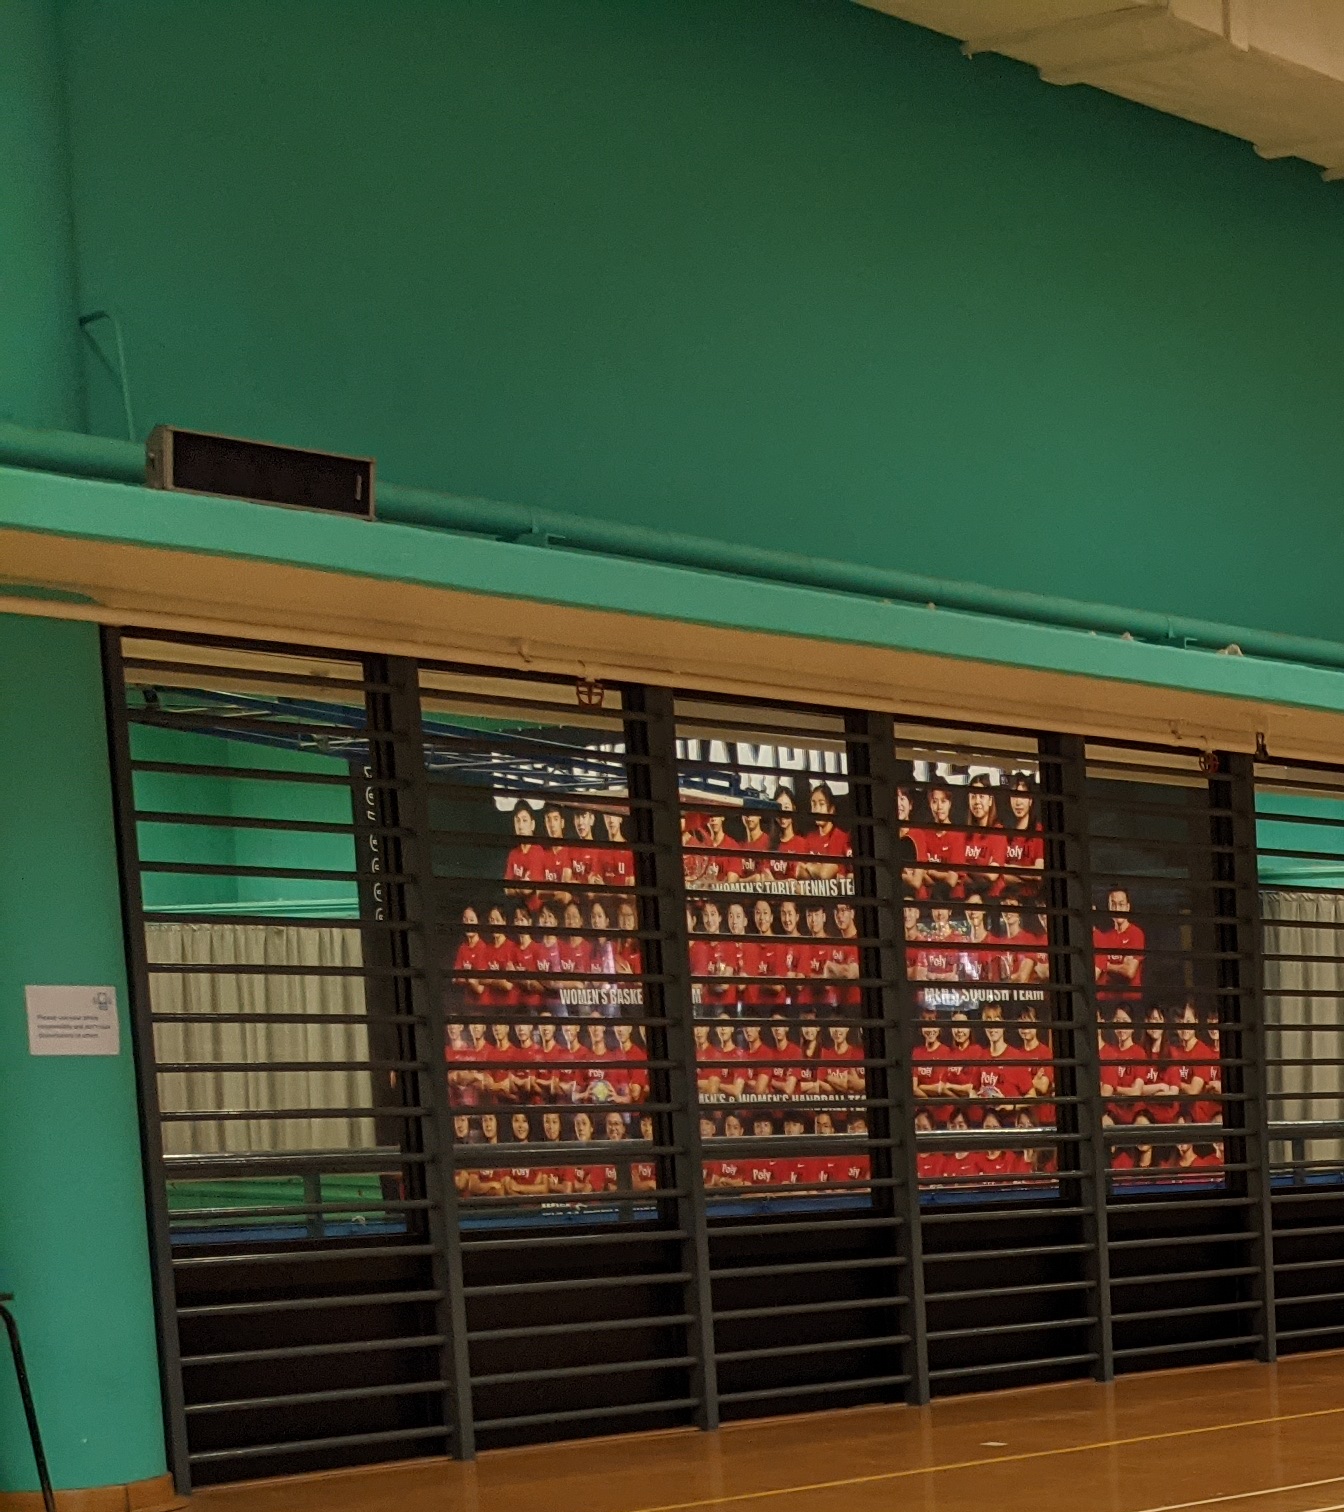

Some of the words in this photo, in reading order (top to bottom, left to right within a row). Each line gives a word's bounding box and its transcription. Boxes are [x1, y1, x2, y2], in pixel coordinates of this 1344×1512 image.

[798, 879, 838, 895] TENNIS
[839, 878, 855, 895] TE
[560, 988, 607, 1005] WOMEN'S
